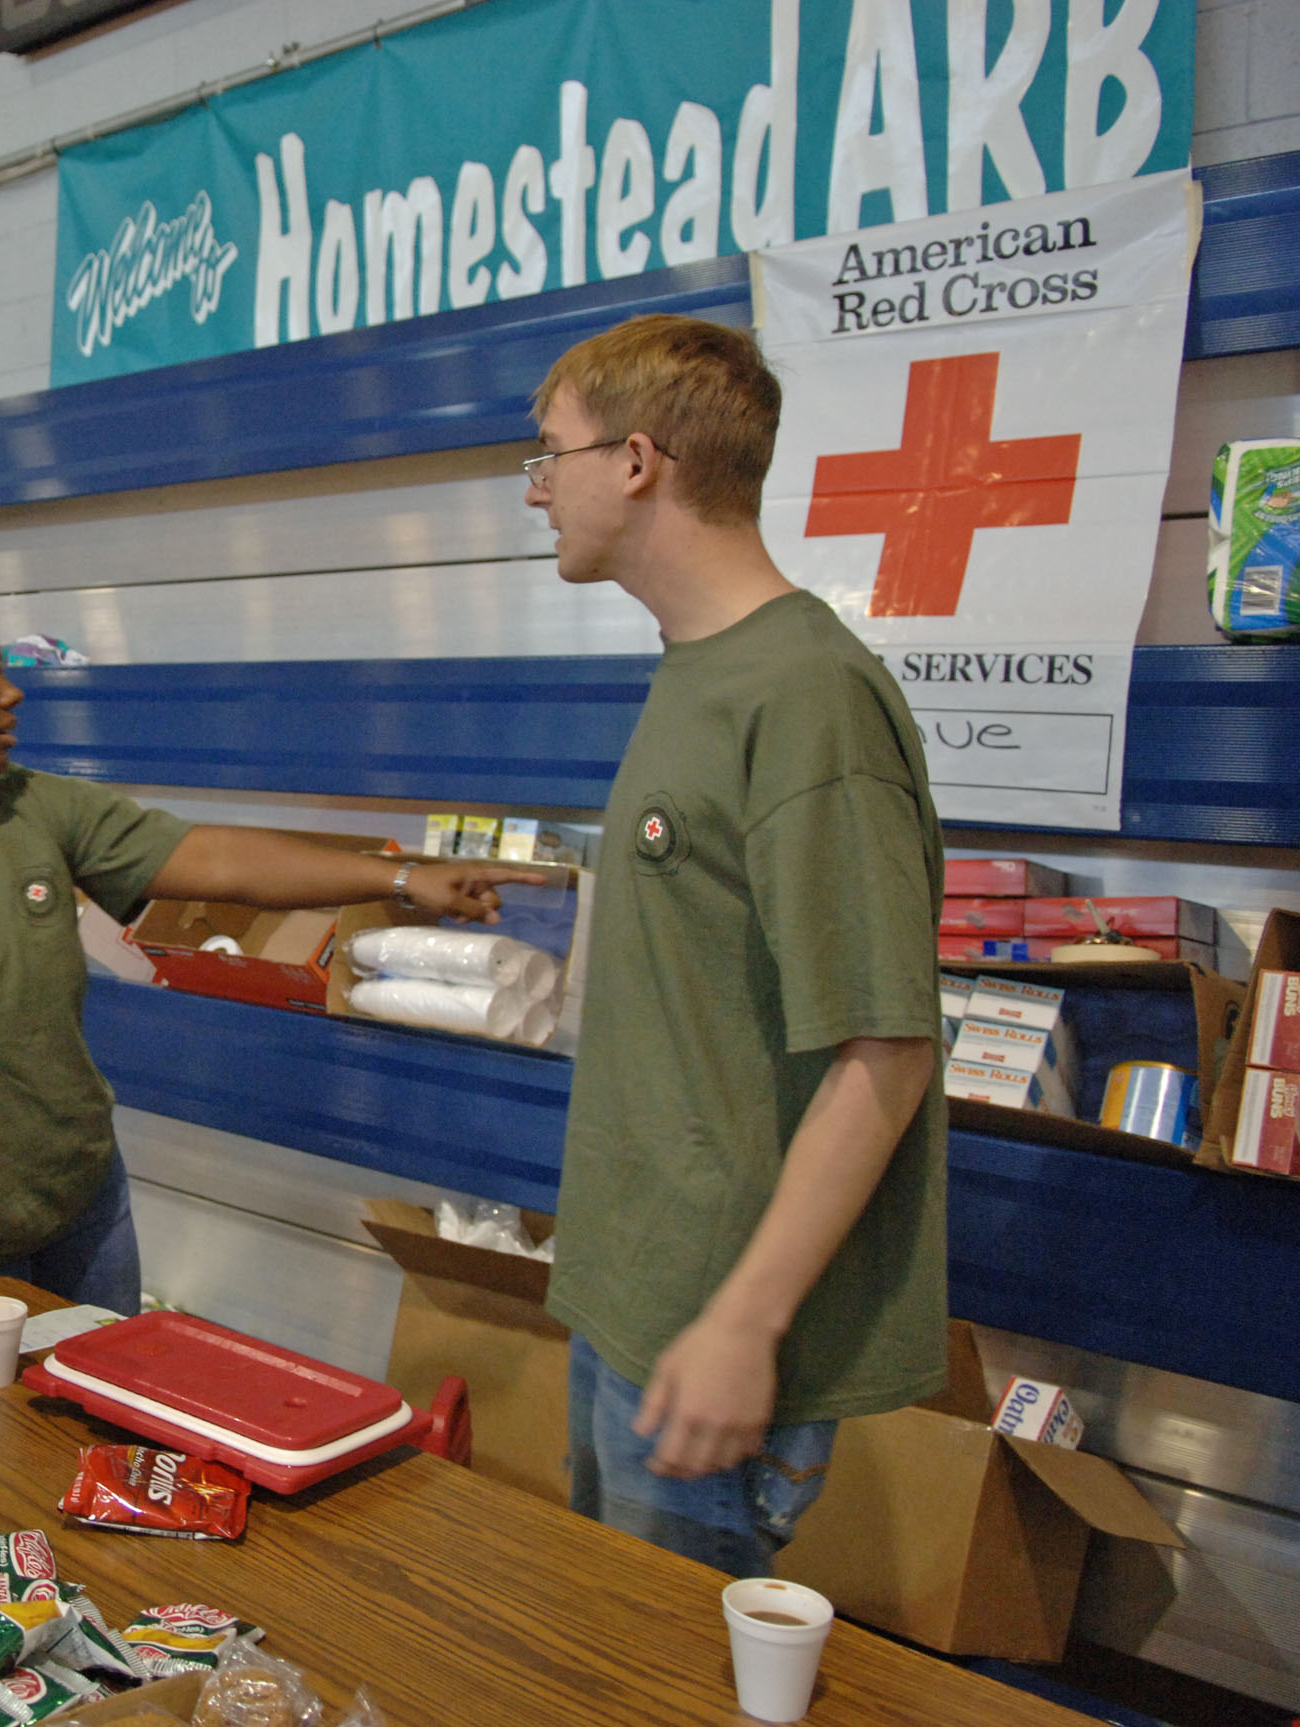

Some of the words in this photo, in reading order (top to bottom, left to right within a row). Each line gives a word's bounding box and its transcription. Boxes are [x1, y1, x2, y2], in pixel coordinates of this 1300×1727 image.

[254, 0, 799, 348] Homestead
[827, 0, 1163, 235] ARB
[831, 216, 1098, 287] American
[830, 289, 929, 335] Red
[942, 266, 1100, 317] Cross
[901, 651, 1094, 686] SERVICES
[1284, 976, 1299, 1017] BUNS
[1270, 1077, 1287, 1119] BUNS
